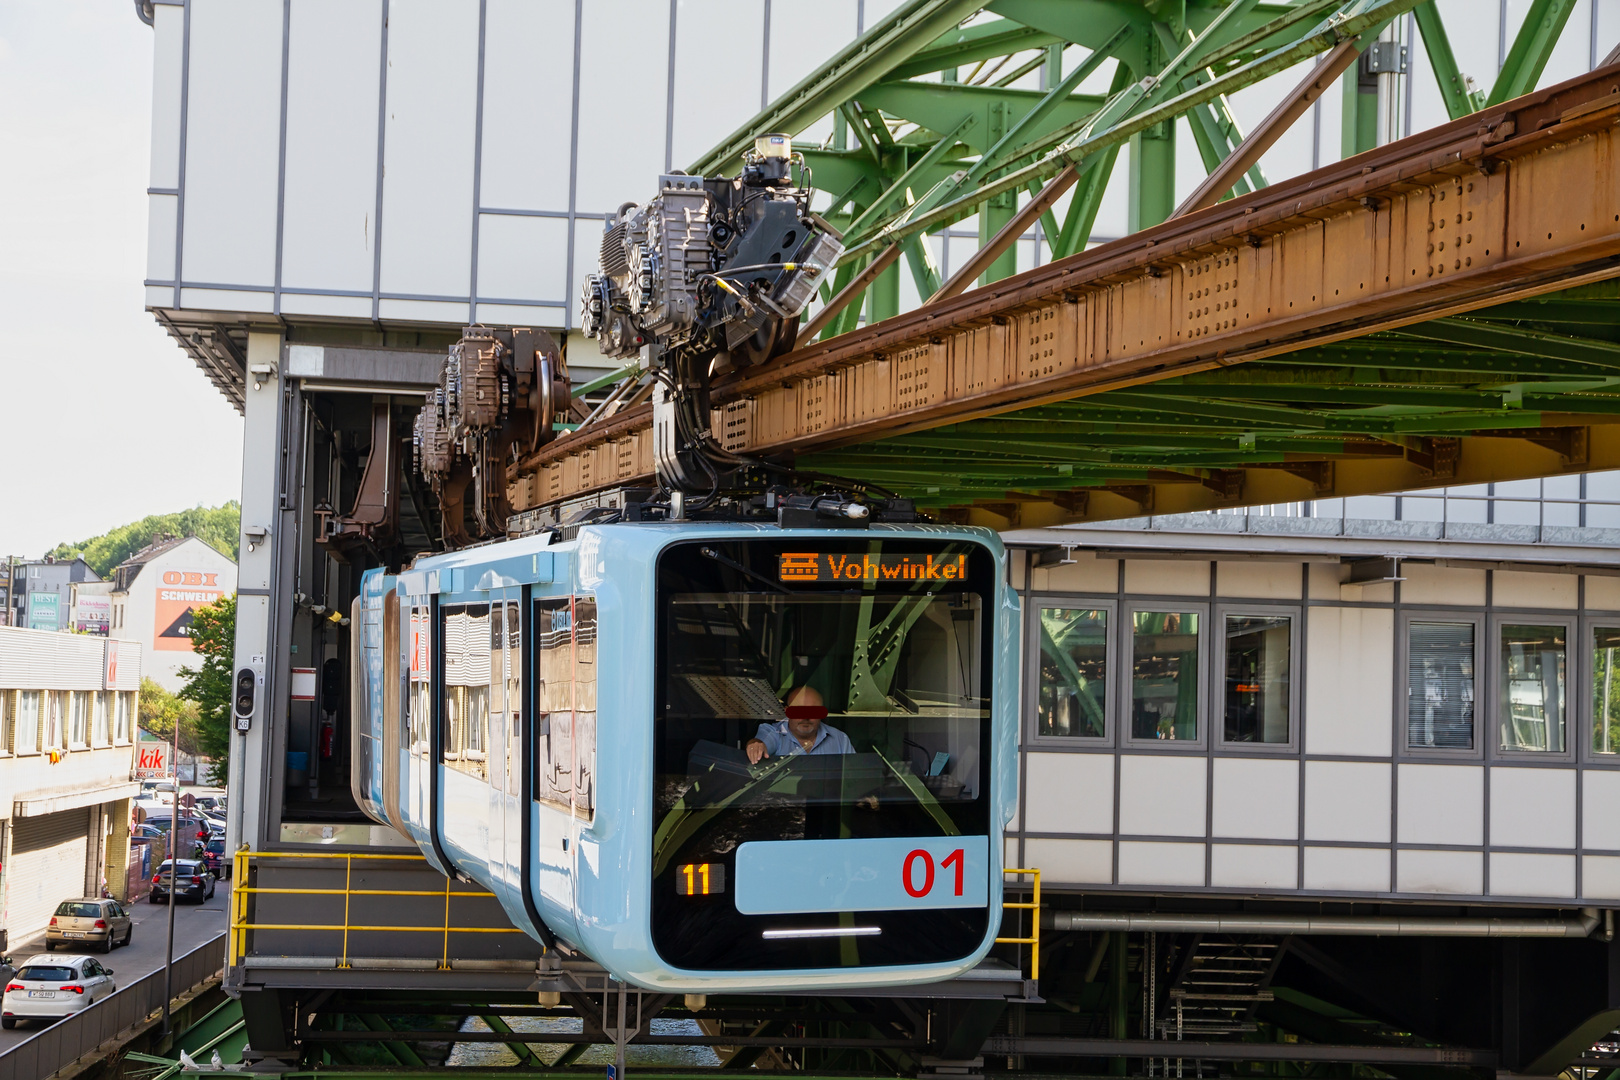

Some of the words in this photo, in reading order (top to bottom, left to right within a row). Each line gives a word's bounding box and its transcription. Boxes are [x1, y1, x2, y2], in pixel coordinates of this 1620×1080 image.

[828, 554, 965, 579] Vohwinkel
[163, 571, 218, 586] OBI
[34, 594, 57, 603] BEST
[161, 590, 218, 602] SCHWELM
[239, 720, 248, 729] K6
[139, 746, 164, 769] kik
[683, 864, 709, 895] 11
[902, 848, 965, 898] 01
